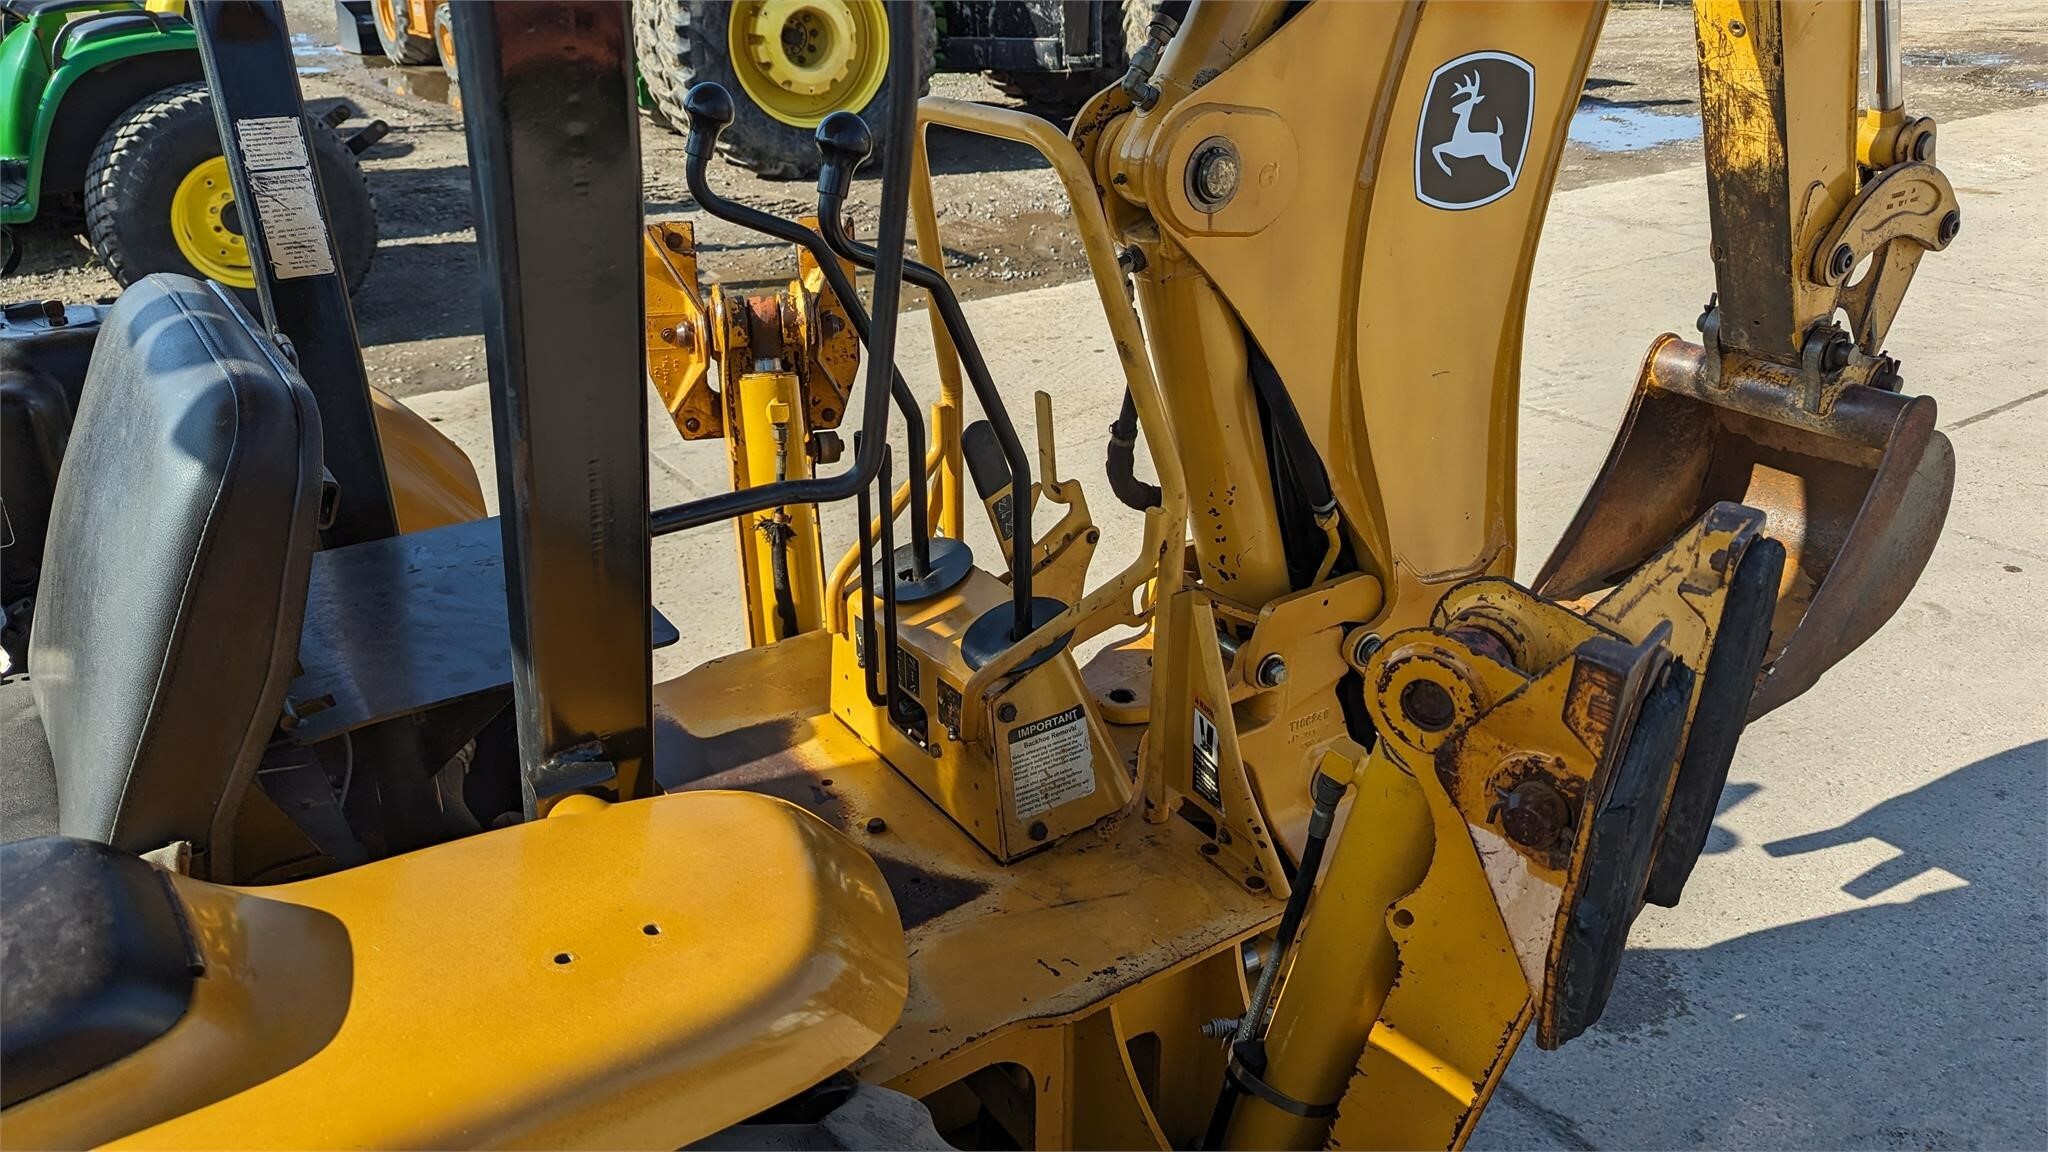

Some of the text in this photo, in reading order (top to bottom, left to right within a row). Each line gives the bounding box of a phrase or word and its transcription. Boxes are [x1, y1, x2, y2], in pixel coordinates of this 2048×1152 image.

[1018, 709, 1078, 738] IMPORTANT
[1024, 724, 1077, 749] Backhoe Removal
